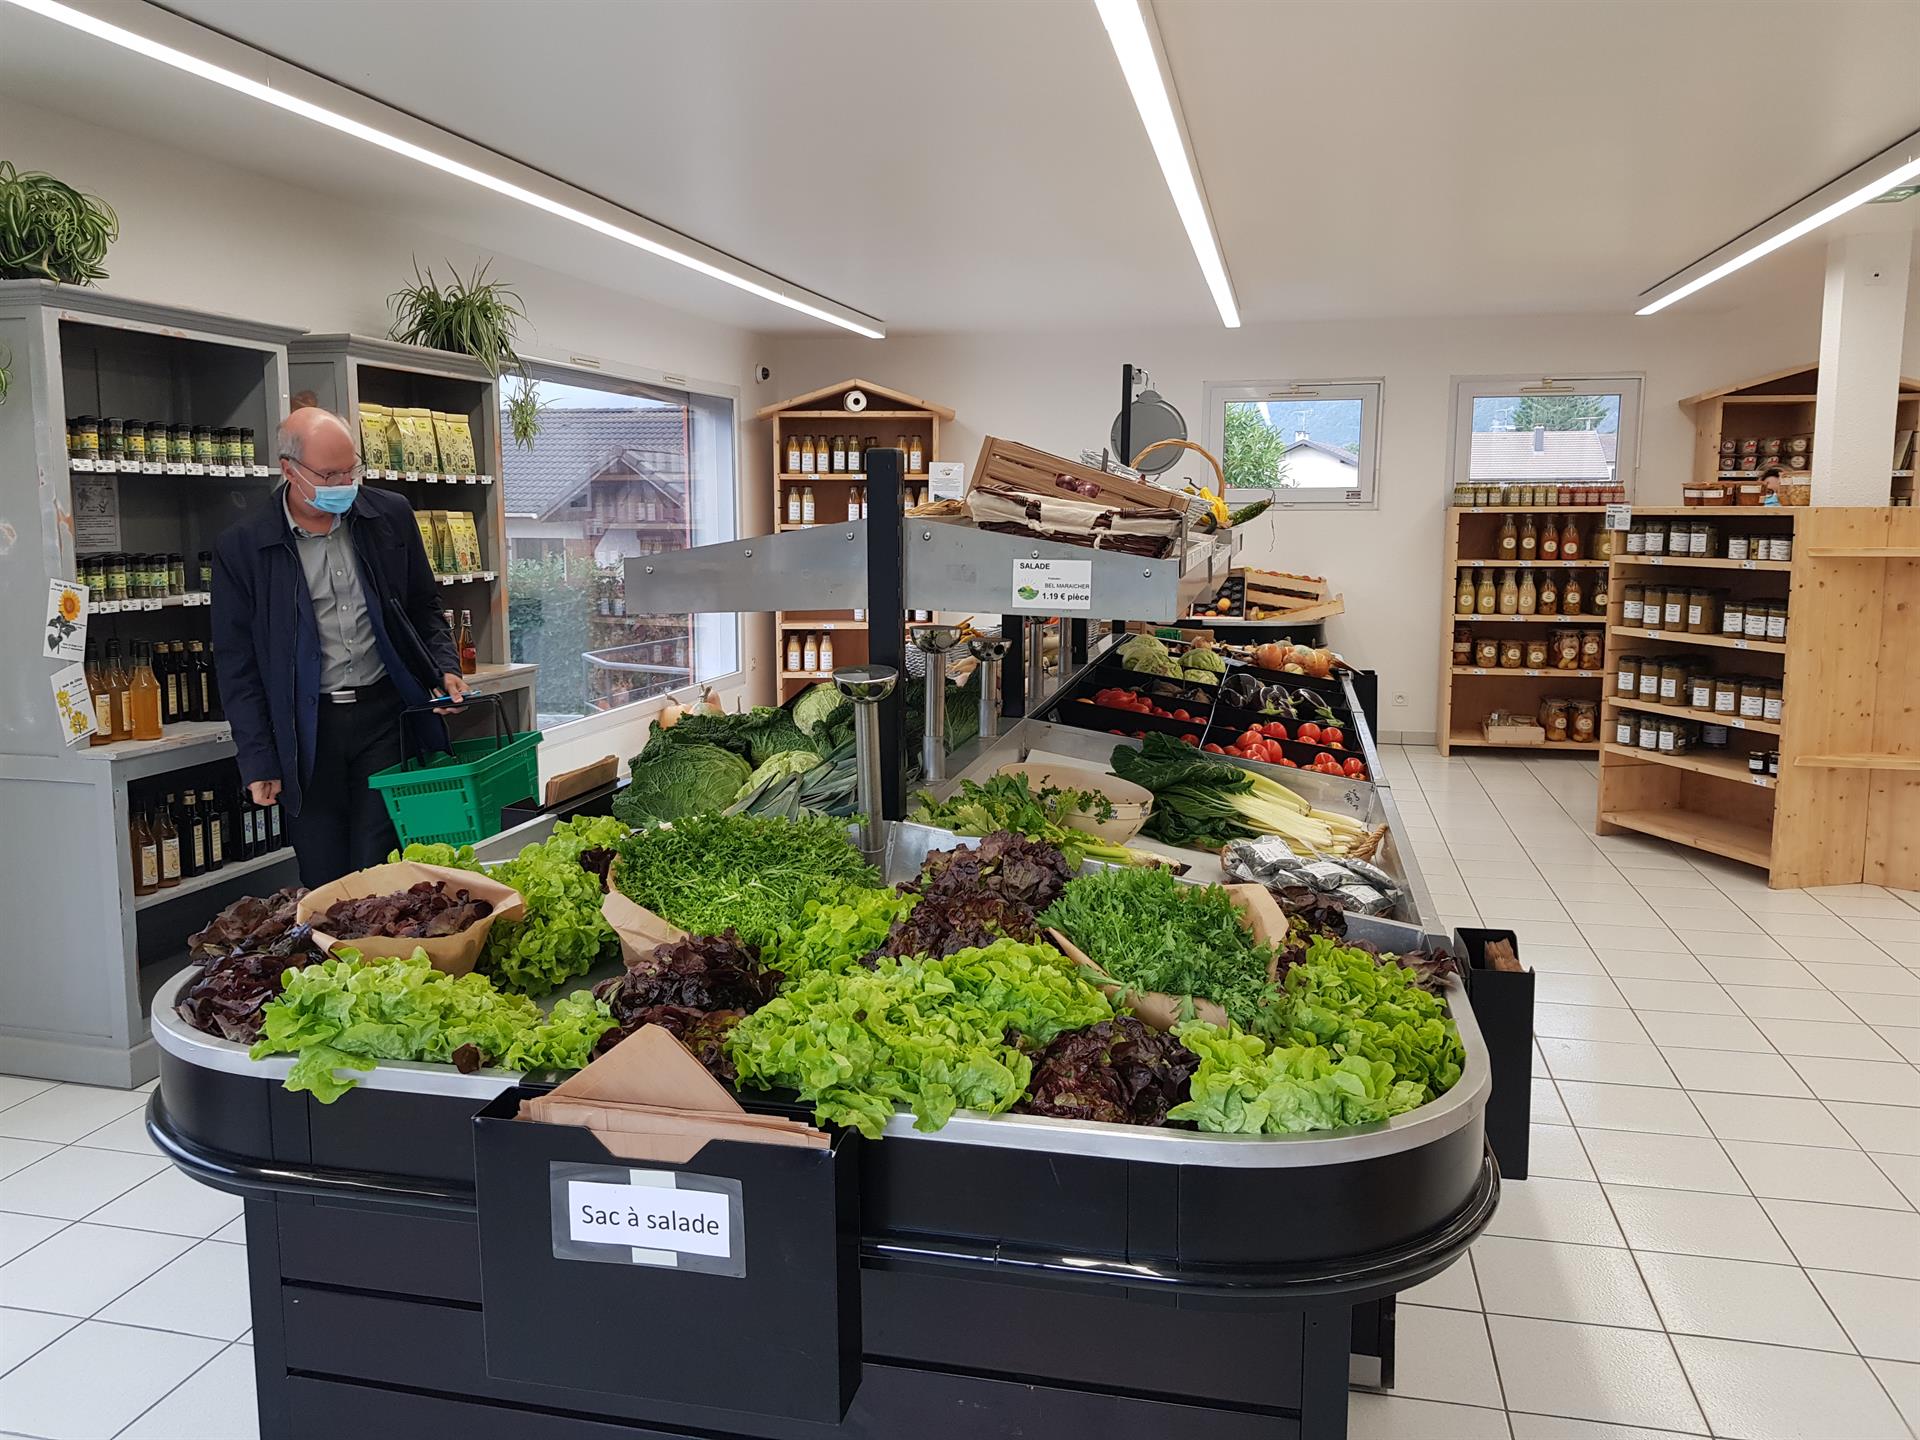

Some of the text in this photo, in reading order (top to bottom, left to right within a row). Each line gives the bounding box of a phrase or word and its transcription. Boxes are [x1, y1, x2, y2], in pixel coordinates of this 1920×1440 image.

[1020, 562, 1051, 570] SALADE
[1042, 592, 1090, 602] 1.19 € pièce
[581, 1204, 720, 1236] Sac à salade
